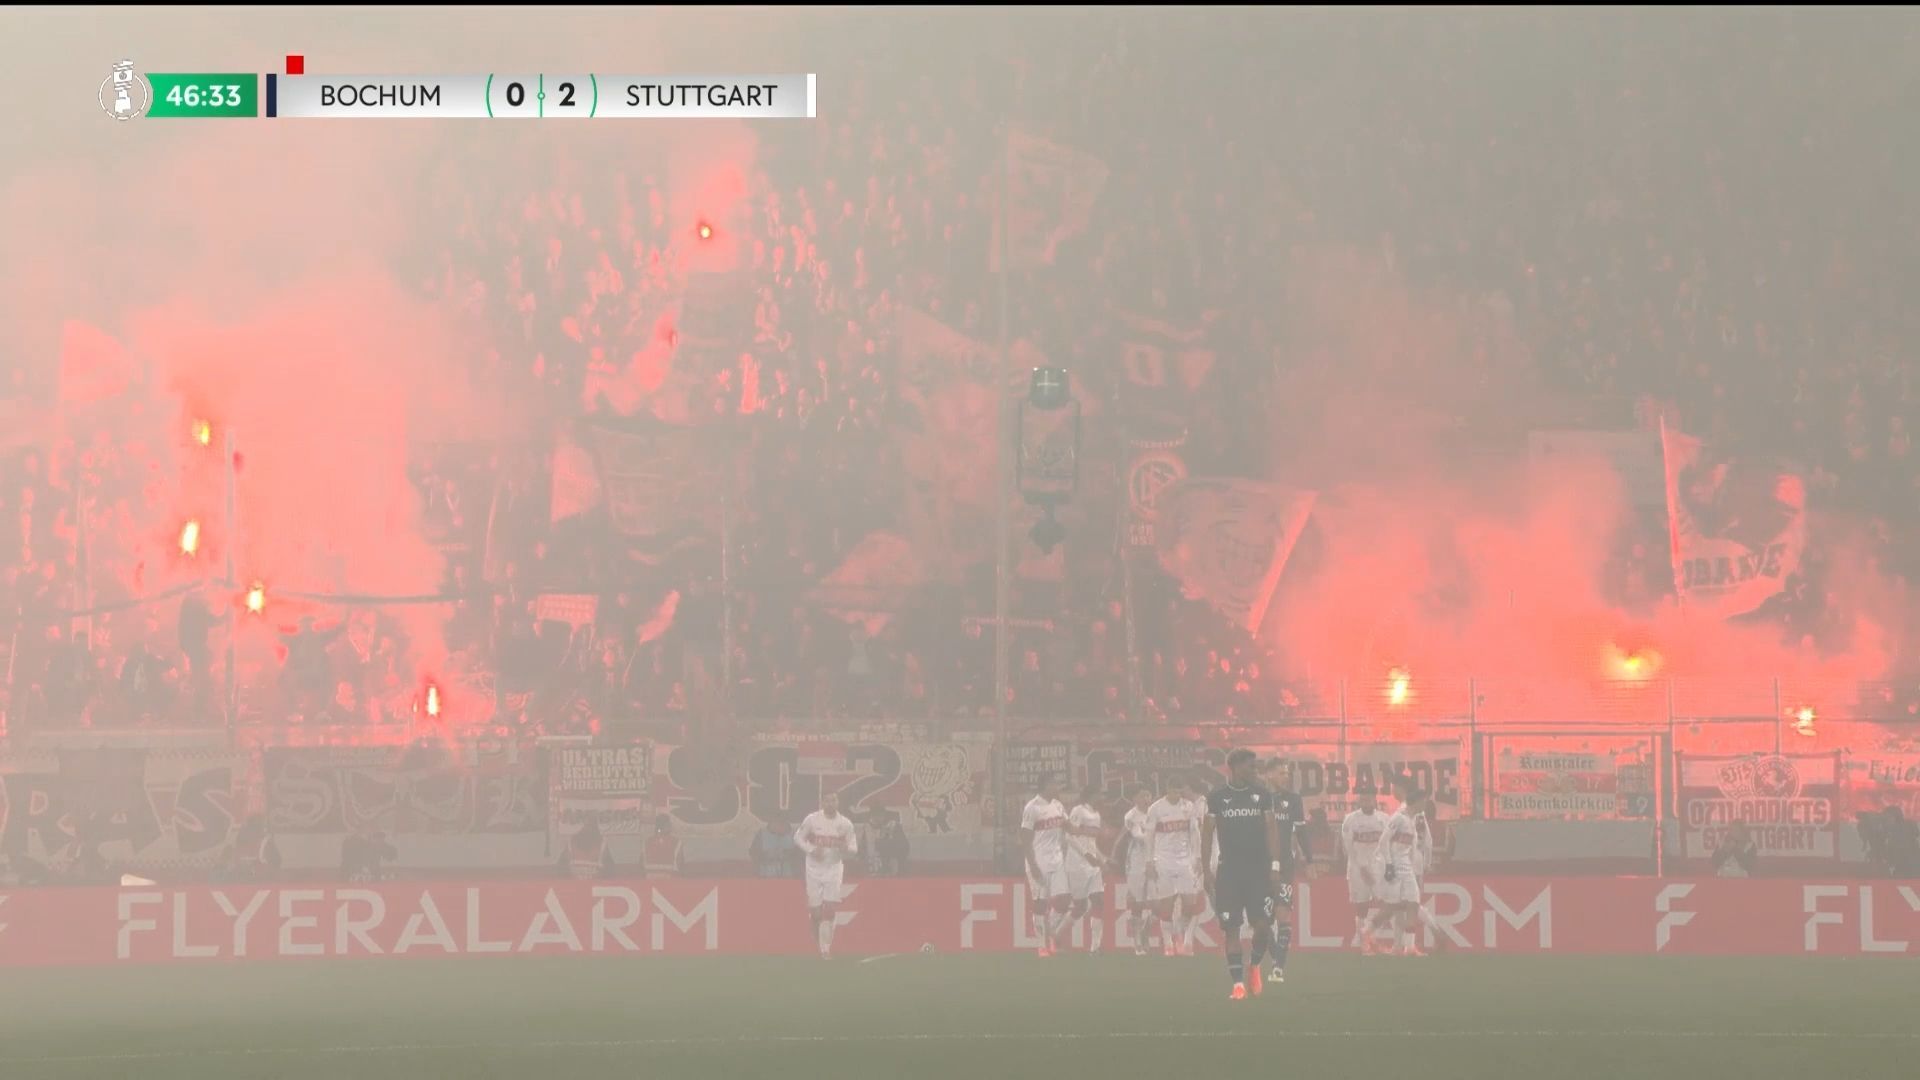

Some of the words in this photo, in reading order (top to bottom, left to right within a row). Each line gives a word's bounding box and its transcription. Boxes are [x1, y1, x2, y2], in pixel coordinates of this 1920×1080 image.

[563, 748, 643, 766] ULTRAS
[561, 778, 646, 791] WIDERSTAND
[1741, 801, 1830, 825] ADDICTS
[116, 886, 720, 959] FLYERALARM
